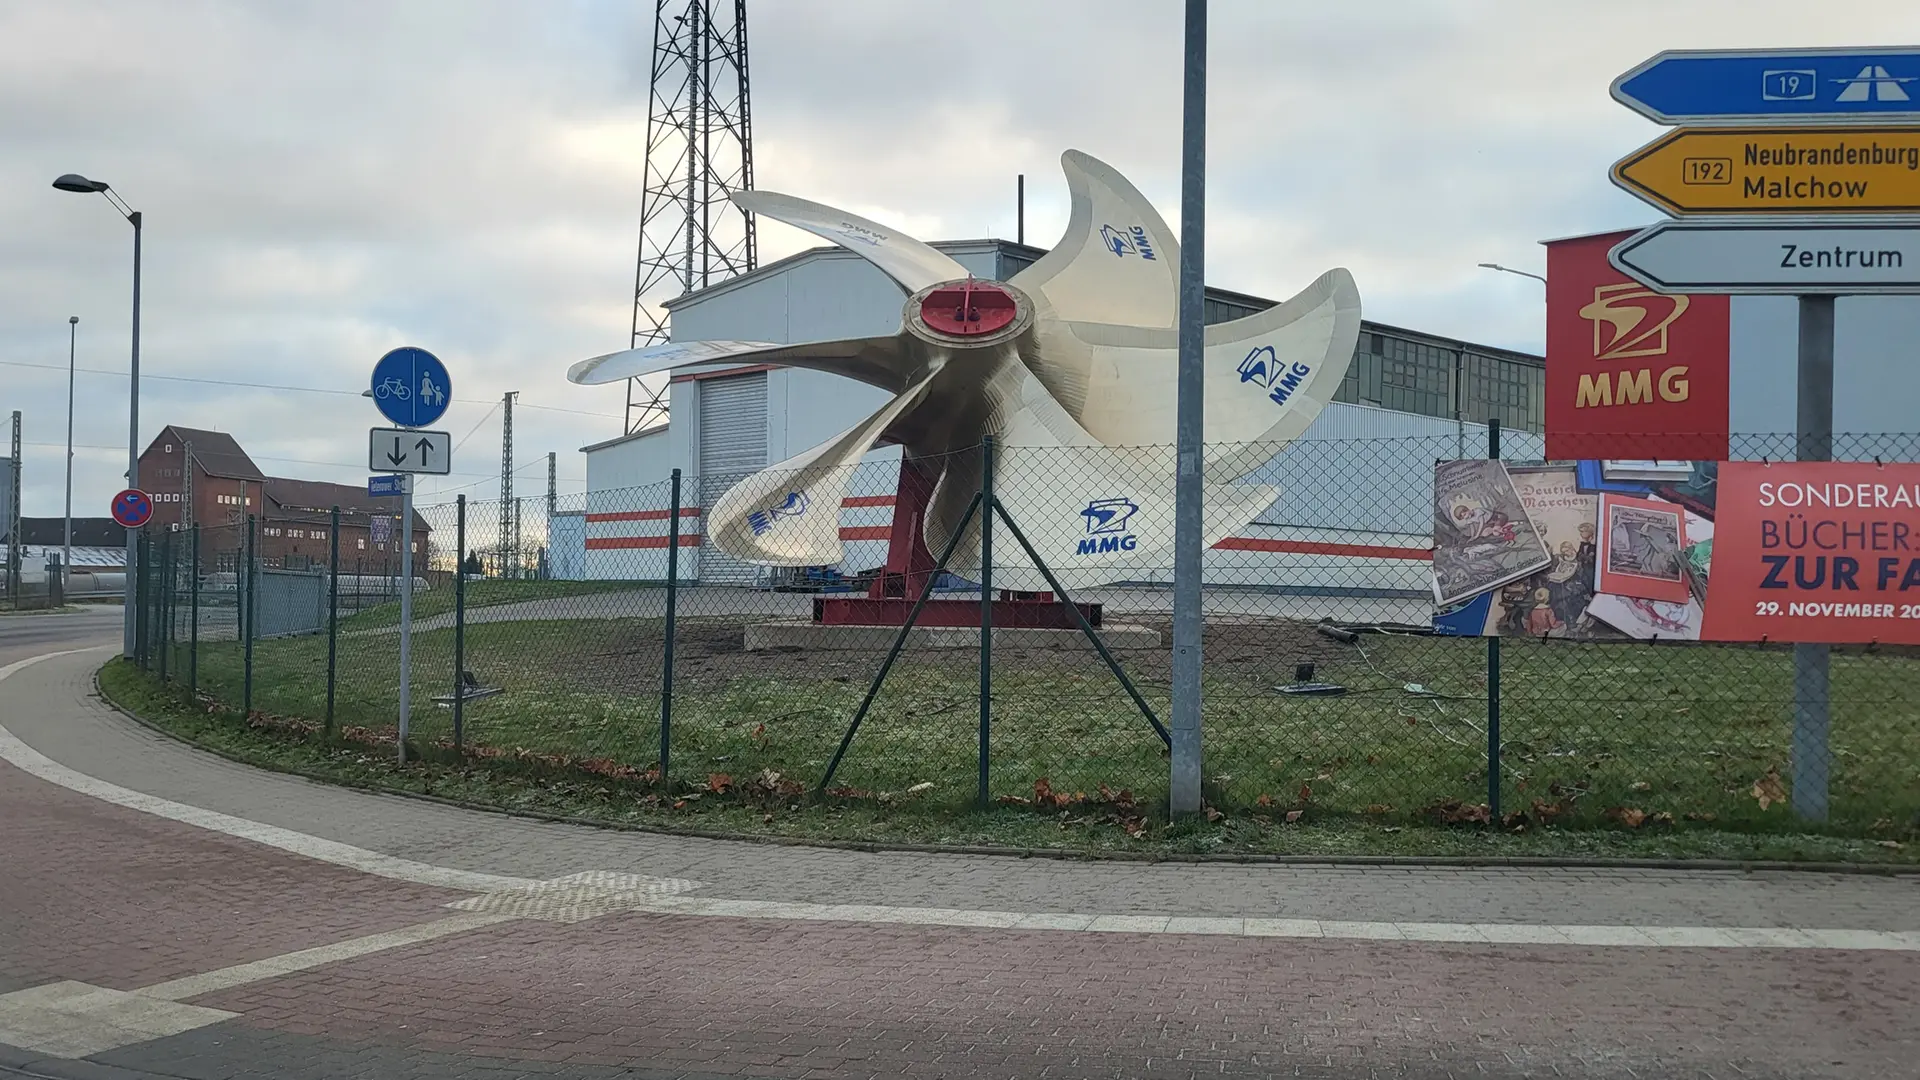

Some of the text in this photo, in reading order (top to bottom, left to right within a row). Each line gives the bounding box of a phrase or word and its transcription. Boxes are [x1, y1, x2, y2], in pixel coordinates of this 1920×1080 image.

[1779, 76, 1800, 94] 19
[1745, 142, 1919, 170] Neubrandenburg
[1691, 162, 1724, 180] 192
[1744, 176, 1868, 198] Malchow
[1128, 225, 1157, 261] MMG
[1780, 245, 1902, 268] Zentrum
[1269, 361, 1311, 406] MMG
[1576, 366, 1689, 409] MMG
[1521, 496, 1589, 508] Märchen
[1076, 535, 1136, 555] MMG
[1759, 555, 1920, 592] ZUR FA
[1755, 602, 1920, 618] 29. NOVEMBER 20
